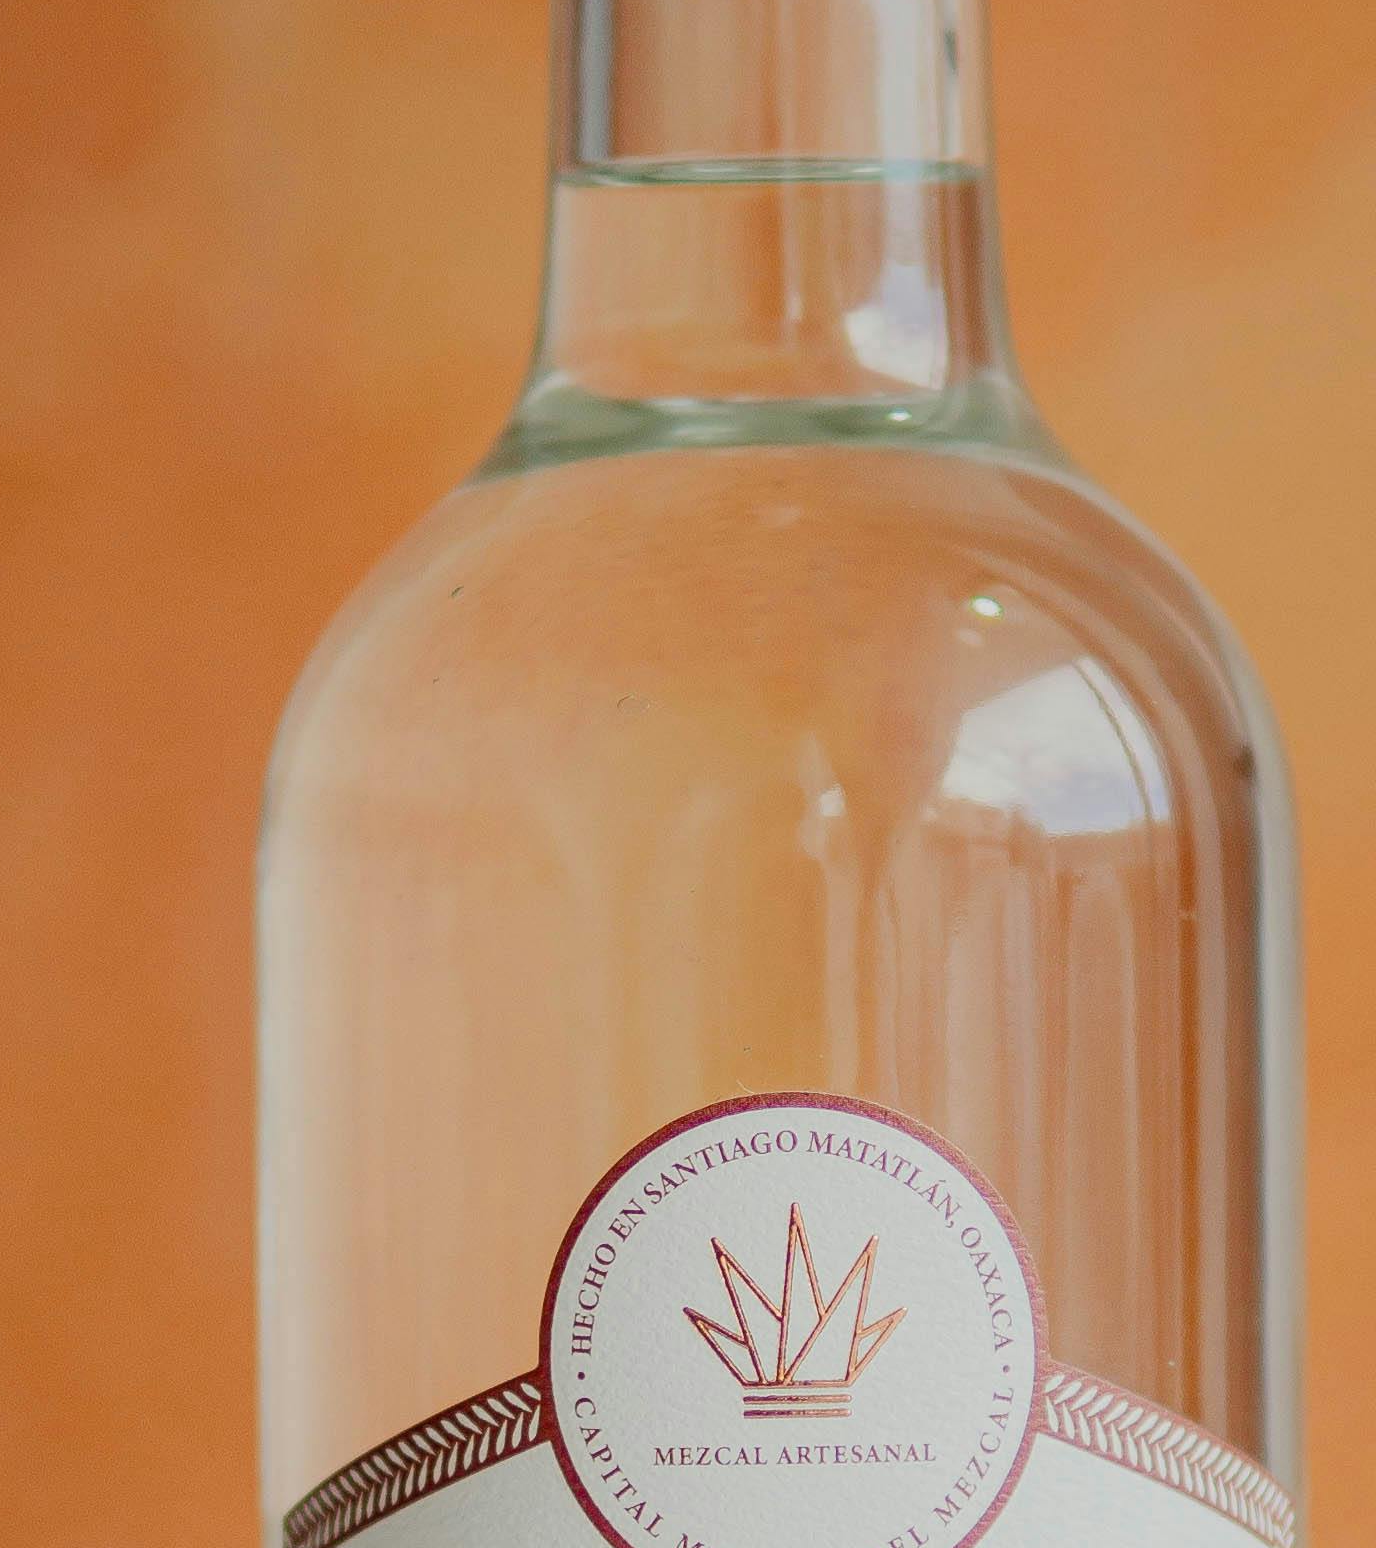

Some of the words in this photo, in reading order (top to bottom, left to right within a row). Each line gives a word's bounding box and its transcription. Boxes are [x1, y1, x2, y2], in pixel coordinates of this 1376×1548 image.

[570, 1243, 618, 1357] HECHO
[609, 1198, 646, 1241] EN
[642, 1129, 798, 1205] SANTIAGO
[806, 1130, 962, 1230] MATATLÁN,
[960, 1226, 1015, 1353] OAXACA
[574, 1396, 663, 1539] CAPITAL
[933, 1386, 1015, 1526] MEZCAL
[653, 1445, 768, 1467] MEZCAL
[776, 1443, 937, 1465] ARTESANAL
